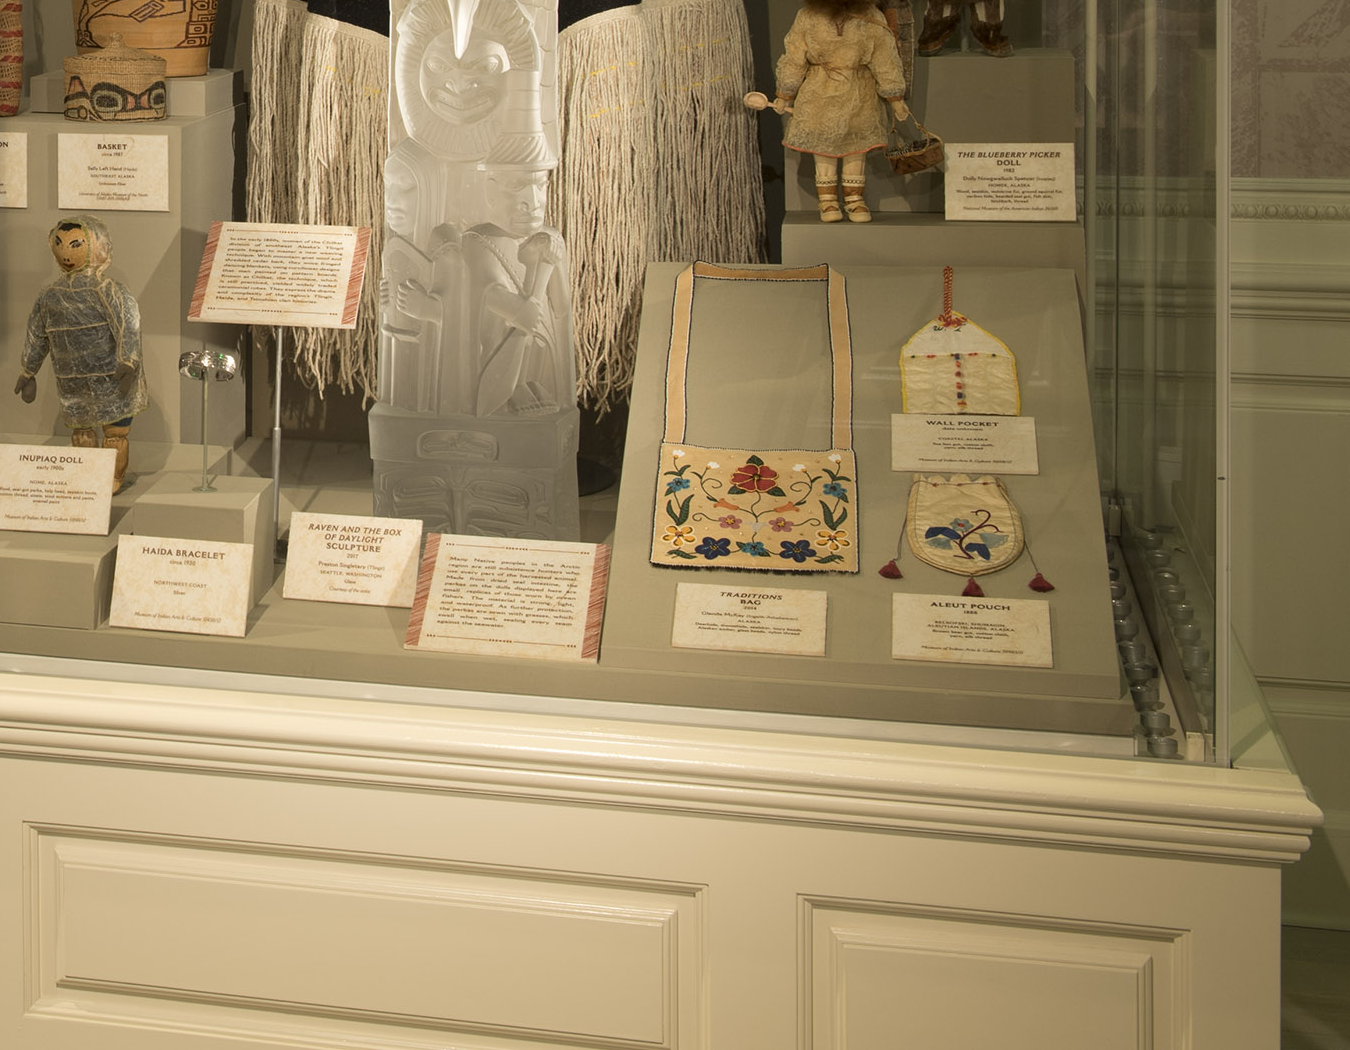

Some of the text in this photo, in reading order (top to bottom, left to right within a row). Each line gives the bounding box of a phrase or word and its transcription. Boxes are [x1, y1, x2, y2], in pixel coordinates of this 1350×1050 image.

[19, 455, 83, 464] INUPIAQ DOLL
[308, 524, 339, 532] RAVEN
[363, 527, 381, 535] THE
[383, 528, 402, 536] BOX
[338, 535, 385, 544] DAYLIGHT
[326, 543, 380, 553] SCULPTURE
[142, 547, 226, 560] HAIDA BRACELET
[720, 592, 782, 600] TRADITIONS
